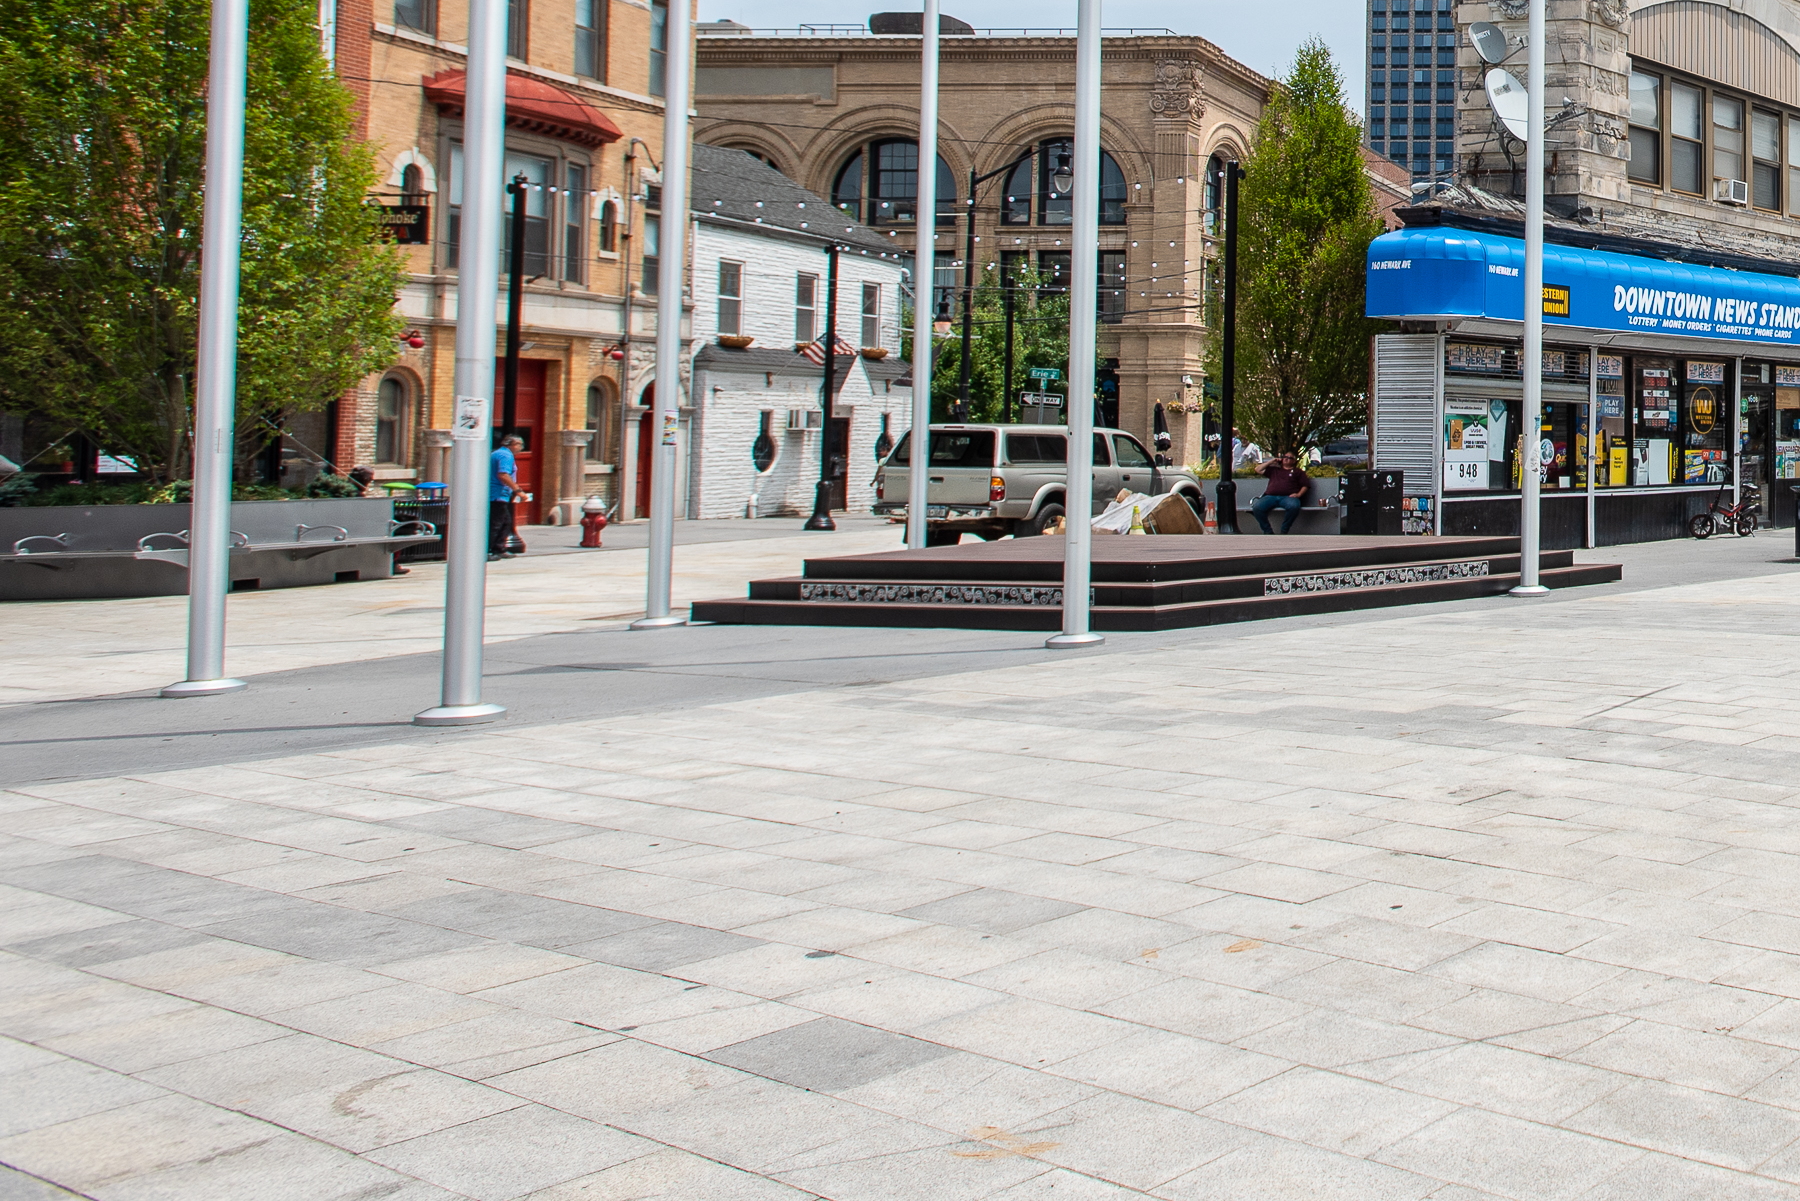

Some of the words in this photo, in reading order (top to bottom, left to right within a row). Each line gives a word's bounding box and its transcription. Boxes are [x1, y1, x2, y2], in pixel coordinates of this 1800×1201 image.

[1380, 260, 1401, 270] NEWARK
[1401, 259, 1412, 269] AVE
[1495, 265, 1512, 276] NEWARK
[1511, 267, 1519, 277] AVE
[1542, 287, 1565, 300] ESTERN
[1543, 301, 1564, 314] UNION
[1613, 284, 1711, 320] DOWNTOWN
[1713, 297, 1758, 328] NEWS
[1629, 316, 1658, 327] LOTTERY
[1662, 318, 1686, 329] MONEY
[1686, 321, 1712, 332] ORDERS
[1716, 324, 1752, 336] CIGARETTES
[1754, 328, 1774, 337] PHONE
[1774, 329, 1792, 339] CARDS
[1465, 346, 1487, 356] PLAY
[1465, 357, 1486, 365] HERE
[1597, 356, 1610, 365] LAY
[1597, 365, 1610, 374] ERE
[1698, 363, 1713, 371] PLAY
[1698, 371, 1713, 379] HERE
[1783, 368, 1796, 377] PLAY
[1604, 399, 1620, 407] PLAY
[1604, 407, 1620, 415] HERE
